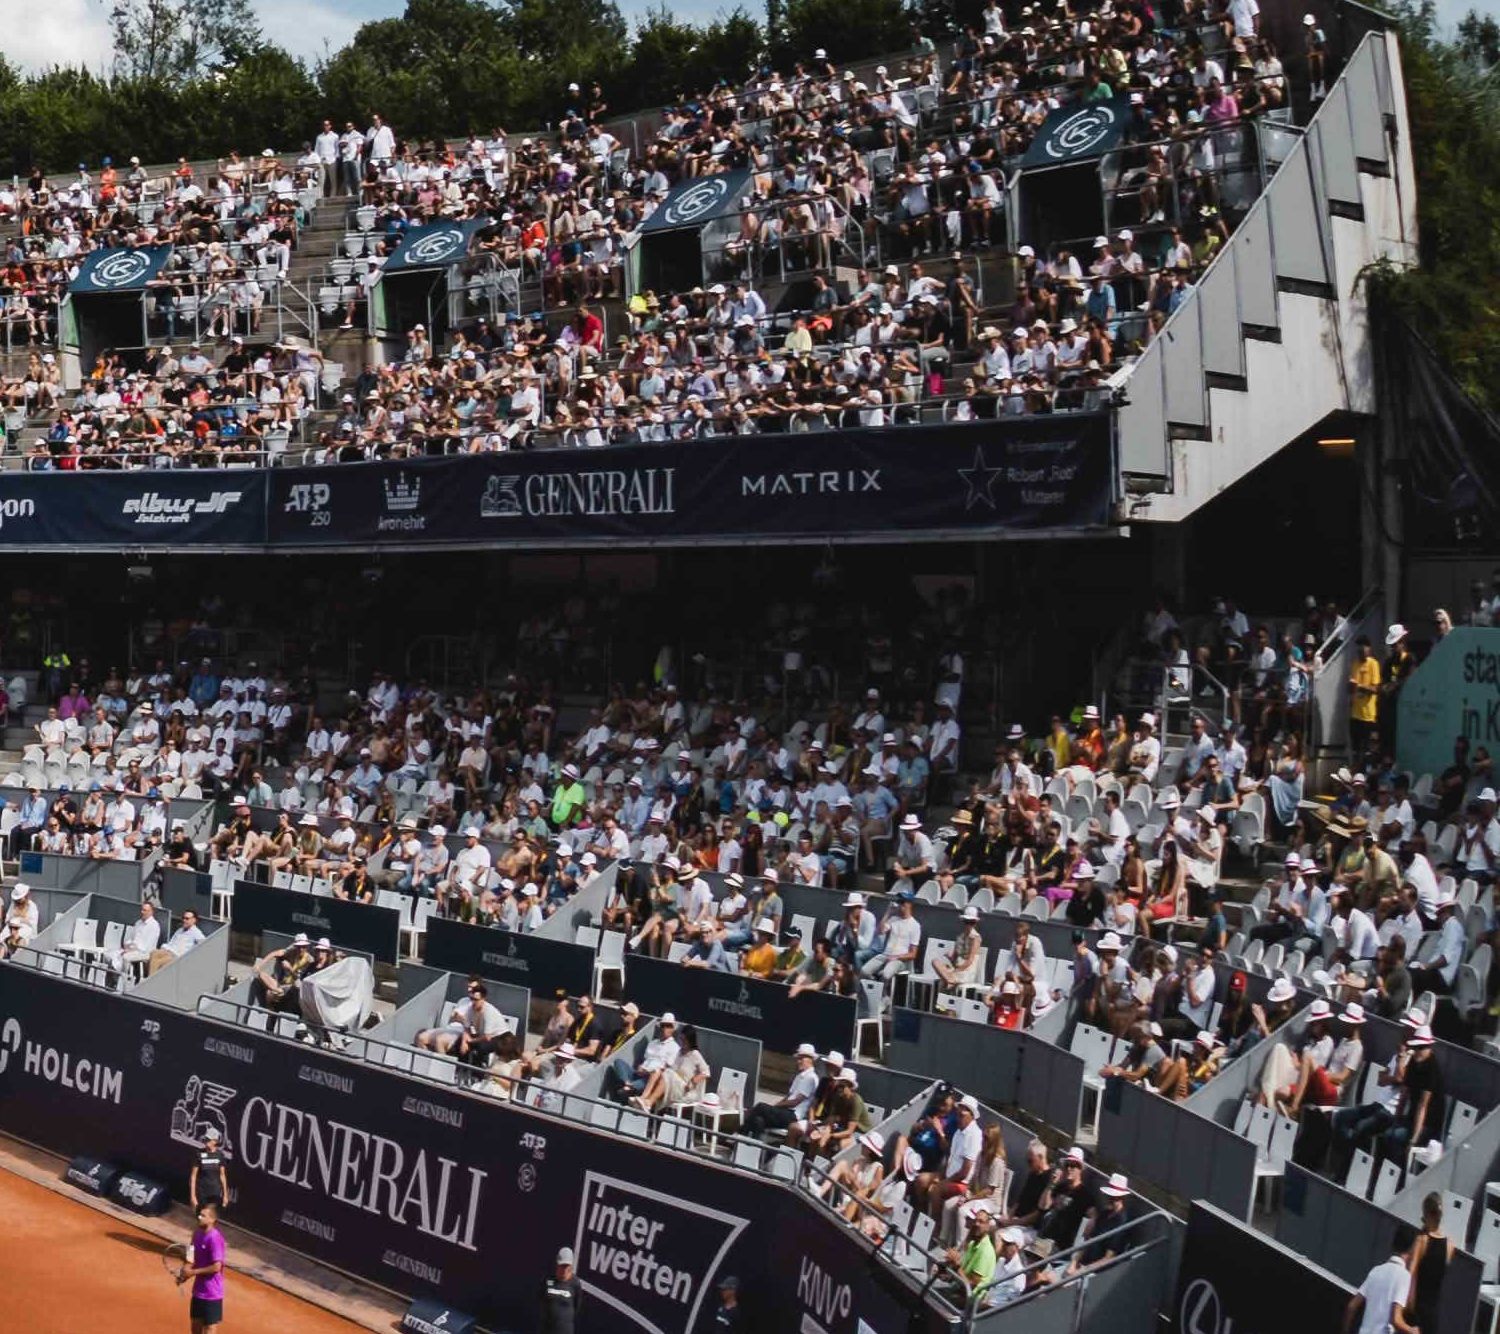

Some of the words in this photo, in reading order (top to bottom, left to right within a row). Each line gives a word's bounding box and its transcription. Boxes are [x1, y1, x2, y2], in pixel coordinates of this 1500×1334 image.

[524, 468, 675, 515] GENERALI
[741, 469, 882, 496] MATRIX
[310, 512, 331, 526] 250
[24, 1040, 124, 1104] HOLCIM
[239, 1096, 489, 1252] GENERALI
[588, 1199, 665, 1250] inter
[589, 1240, 693, 1304] wetten
